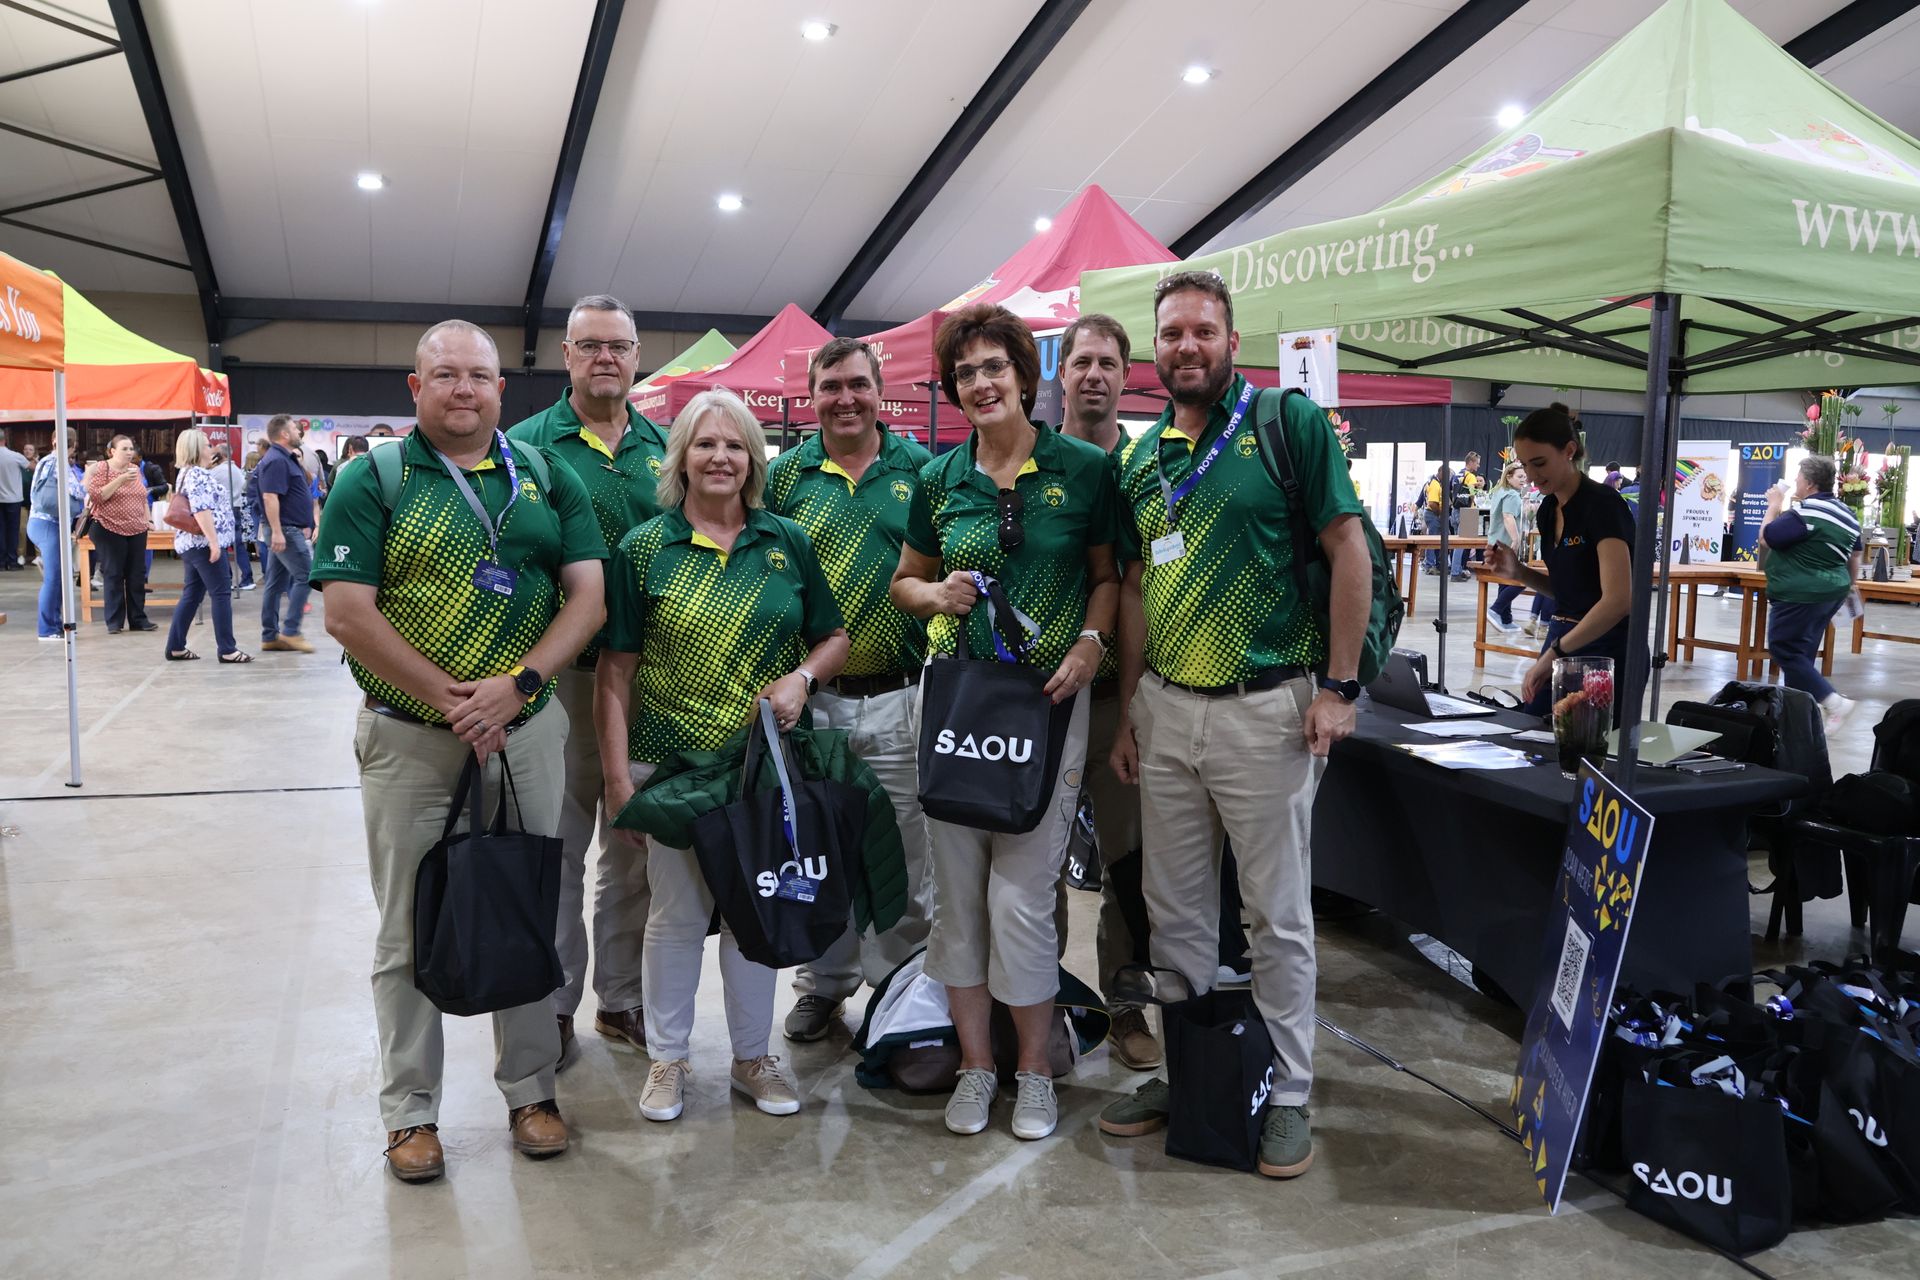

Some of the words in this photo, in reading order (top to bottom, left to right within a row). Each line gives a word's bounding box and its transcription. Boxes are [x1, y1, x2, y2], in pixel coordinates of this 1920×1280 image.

[1229, 218, 1474, 296] Discovering...
[7, 284, 41, 343] You
[1298, 356, 1309, 383] 4
[743, 389, 784, 412] Keep
[1222, 411, 1242, 440] SAOU
[1197, 447, 1219, 476] SAOU
[1742, 445, 1784, 460] SAOU
[504, 456, 517, 479] SAOU
[934, 728, 1033, 763] SAOU
[1579, 776, 1638, 864] SAOU
[1632, 1161, 1733, 1206] SAOU
